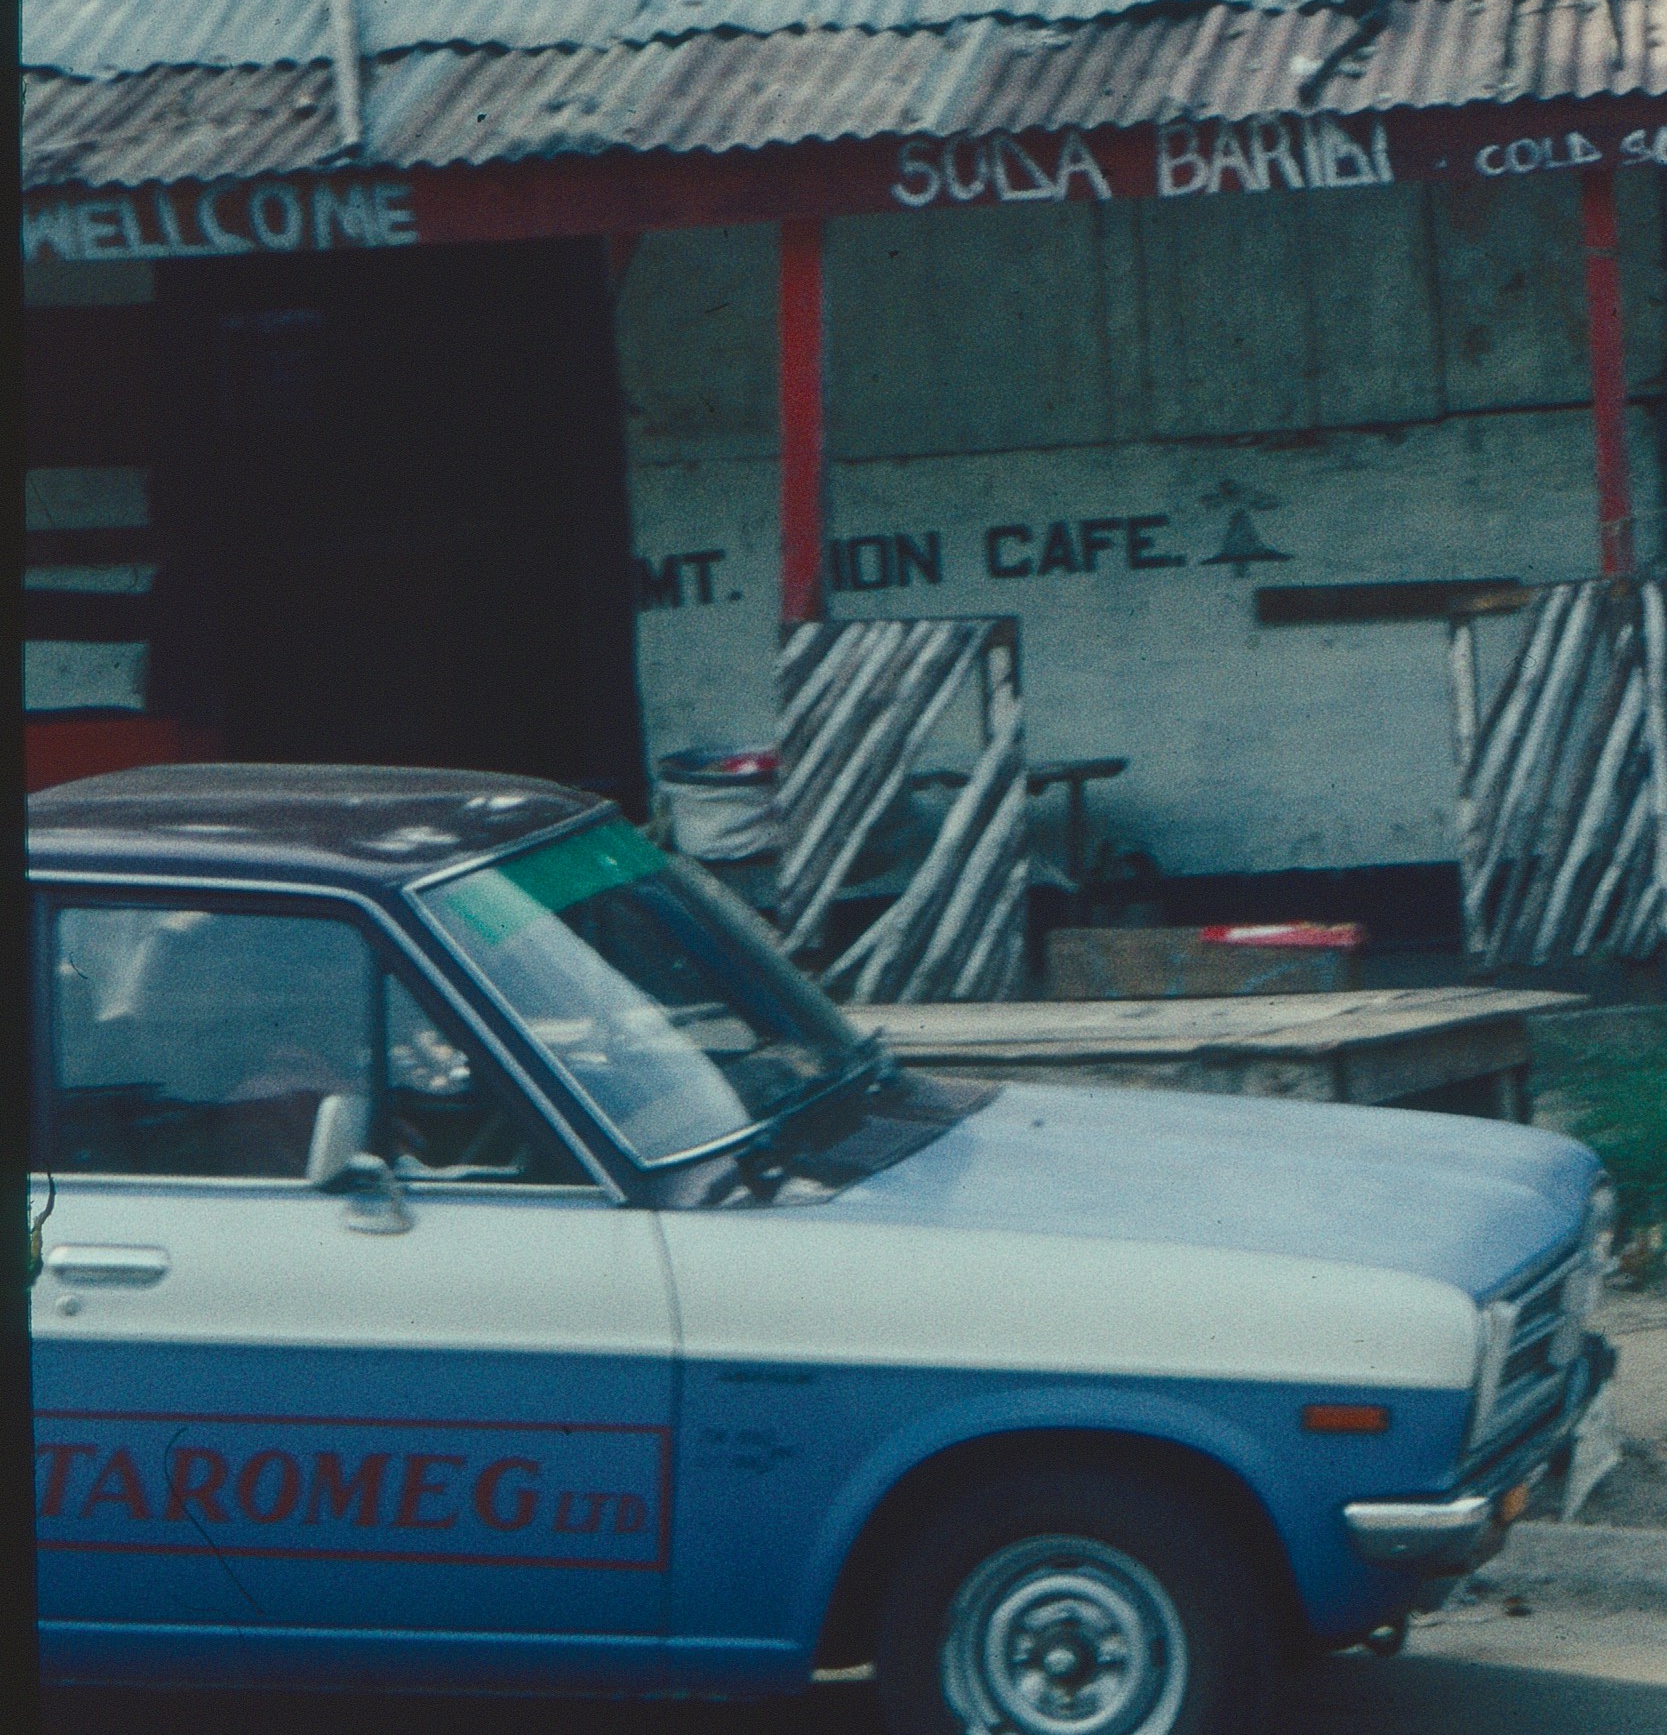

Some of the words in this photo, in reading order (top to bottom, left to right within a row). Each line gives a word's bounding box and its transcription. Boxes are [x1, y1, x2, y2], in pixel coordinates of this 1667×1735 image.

[891, 129, 1113, 207] SODA
[1473, 130, 1602, 176] COLD
[24, 181, 421, 260] WELLCOME
[553, 1490, 651, 1535] LTD
